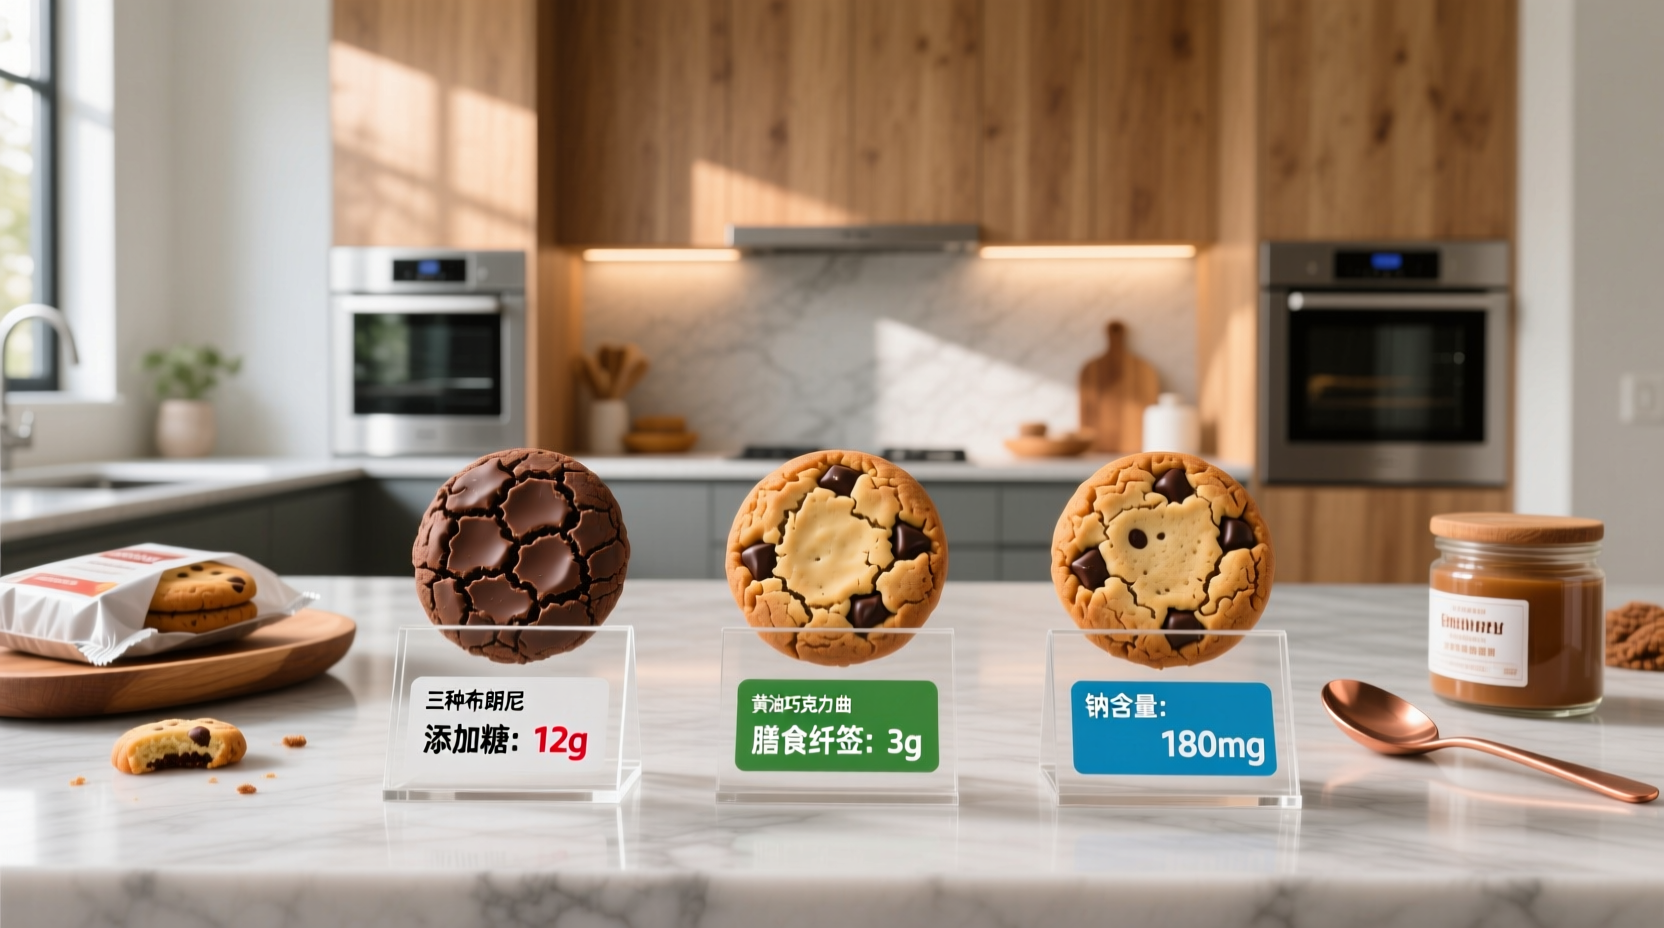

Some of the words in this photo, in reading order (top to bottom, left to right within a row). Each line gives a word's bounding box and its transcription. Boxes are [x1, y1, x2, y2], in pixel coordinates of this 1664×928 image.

[751, 693, 852, 714] 黄油巧克力曲
[1085, 692, 1166, 719] 钠含量：
[423, 723, 519, 754] 添加糖：
[534, 725, 588, 761] 12g
[887, 728, 922, 761] 3g
[1161, 729, 1265, 767] 180mg
